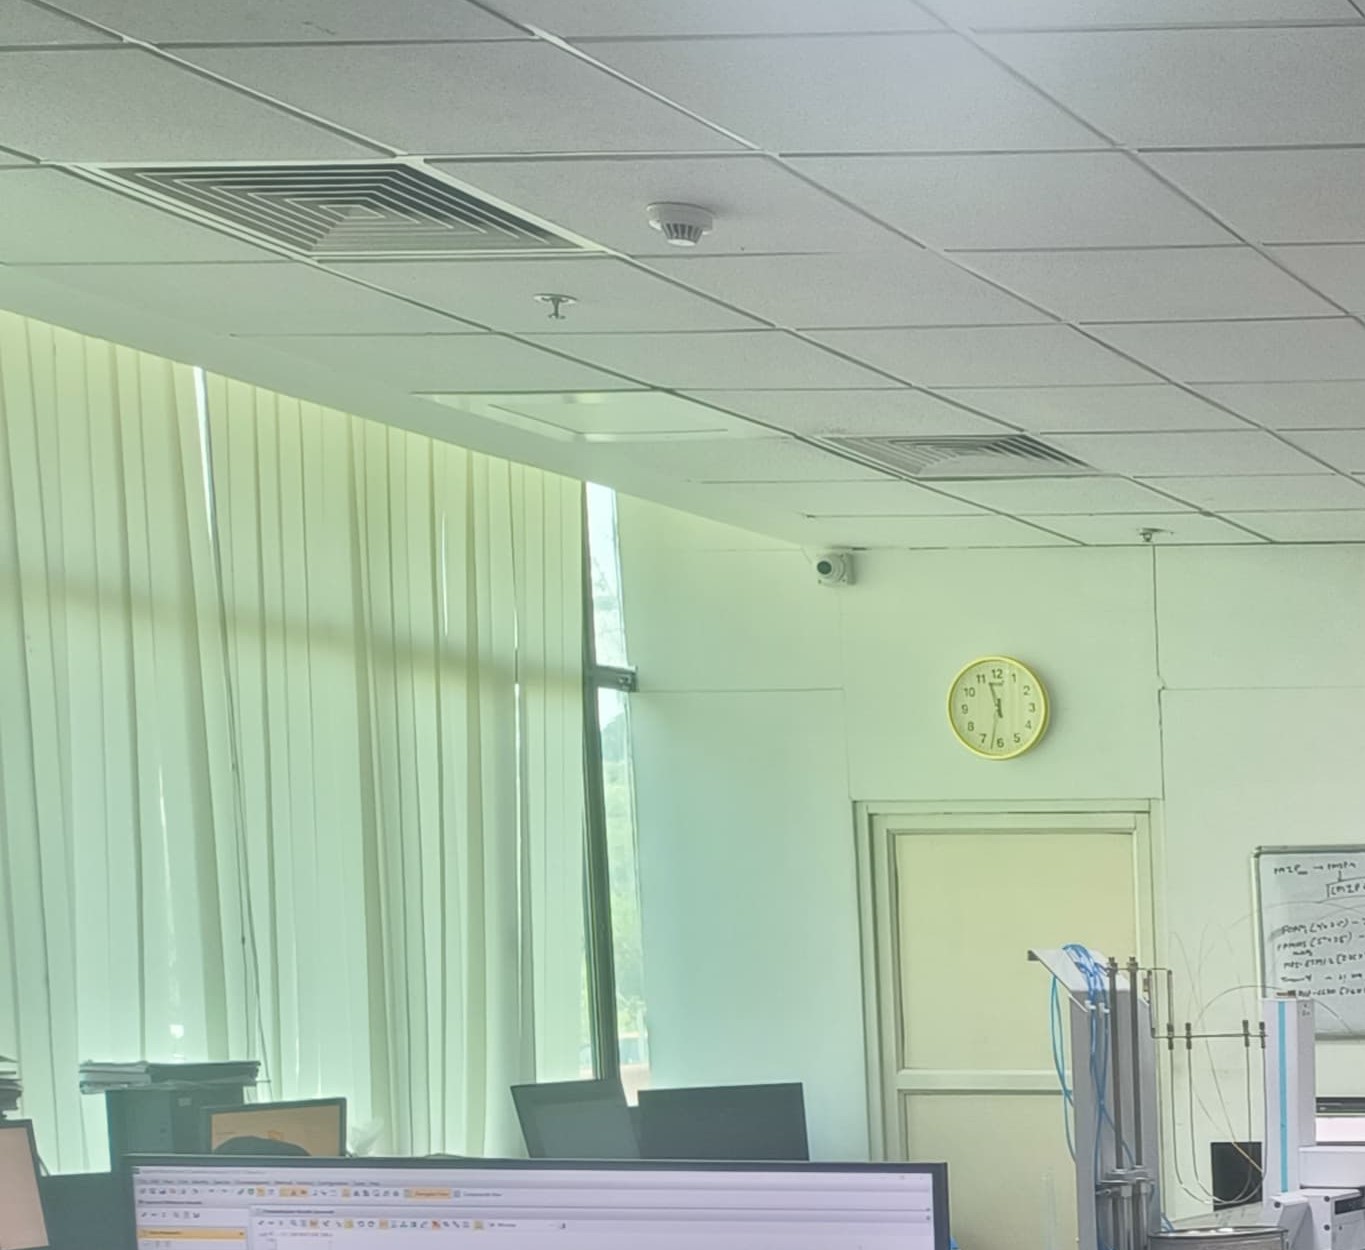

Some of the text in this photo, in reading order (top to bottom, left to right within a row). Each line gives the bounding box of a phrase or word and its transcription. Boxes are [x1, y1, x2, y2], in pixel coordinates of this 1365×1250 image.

[976, 673, 985, 683] 11
[992, 668, 1002, 679] 12
[964, 687, 975, 697] 10
